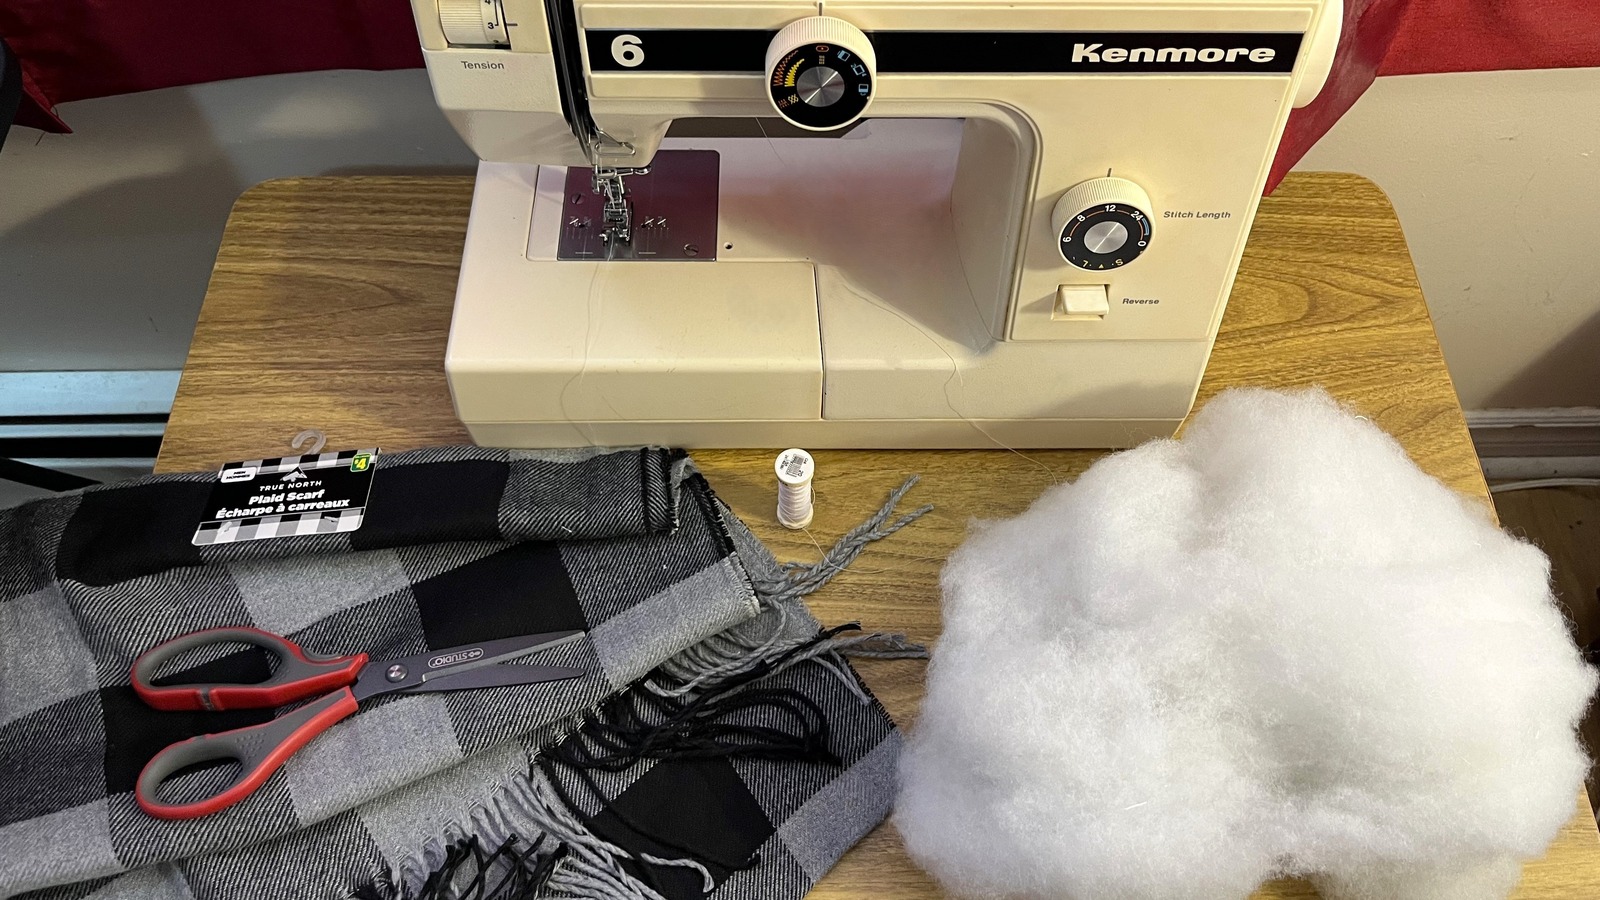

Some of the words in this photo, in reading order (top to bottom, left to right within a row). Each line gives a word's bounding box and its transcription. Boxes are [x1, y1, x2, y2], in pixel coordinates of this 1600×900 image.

[611, 34, 645, 67] 6
[1071, 43, 1276, 63] Kenmore
[460, 60, 505, 70] Tension
[1076, 214, 1086, 222] 8
[1104, 204, 1117, 212] 12
[1130, 210, 1144, 221] 24
[1163, 210, 1194, 218] Stitch
[1196, 211, 1231, 219] Length
[1122, 297, 1160, 305] Reverse
[354, 457, 367, 470] $4
[260, 483, 285, 492] TRUE
[287, 480, 322, 489] NORTH
[248, 493, 285, 505] Plaid
[286, 489, 325, 501] Scarf
[215, 505, 274, 519] Écharpe
[275, 503, 286, 513] à
[287, 499, 351, 512] carreaux
[434, 652, 468, 665] STUDIO
